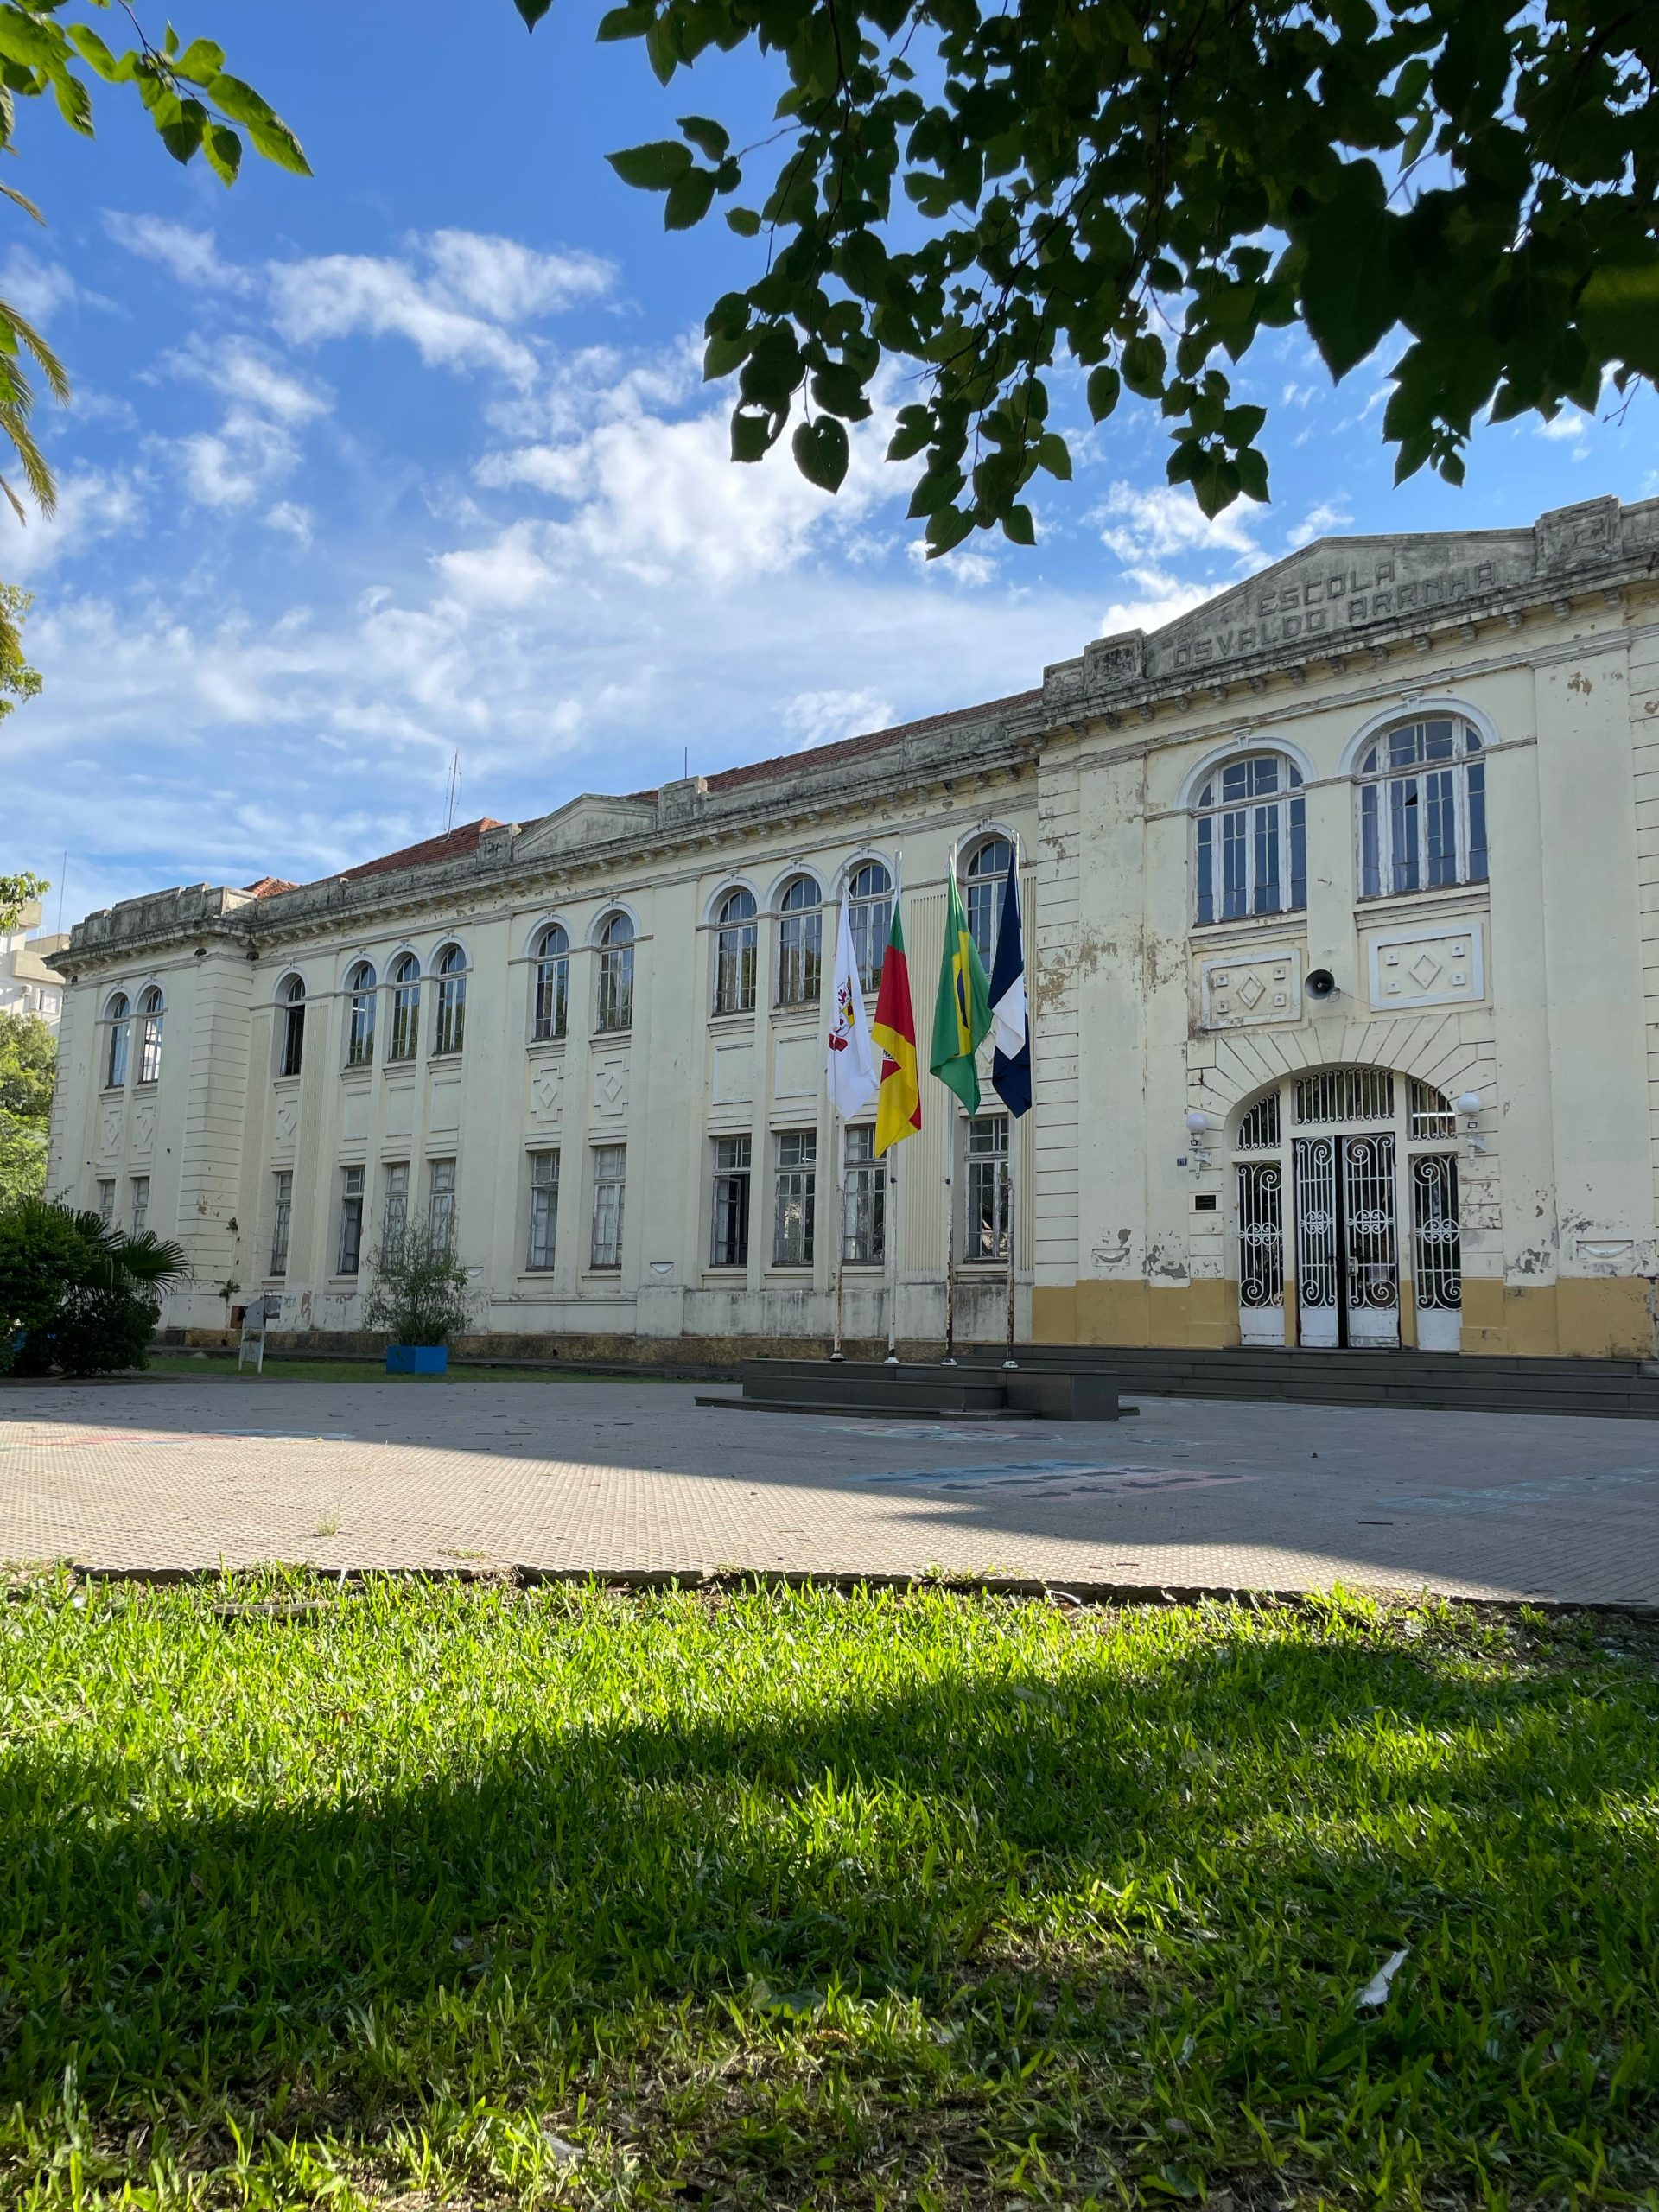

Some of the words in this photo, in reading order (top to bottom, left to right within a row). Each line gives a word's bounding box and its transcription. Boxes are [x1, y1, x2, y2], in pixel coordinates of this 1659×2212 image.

[1173, 607, 1327, 669] OSVALDO
[1348, 562, 1497, 623] ARANHA
[1257, 560, 1395, 618] ESCOLA
